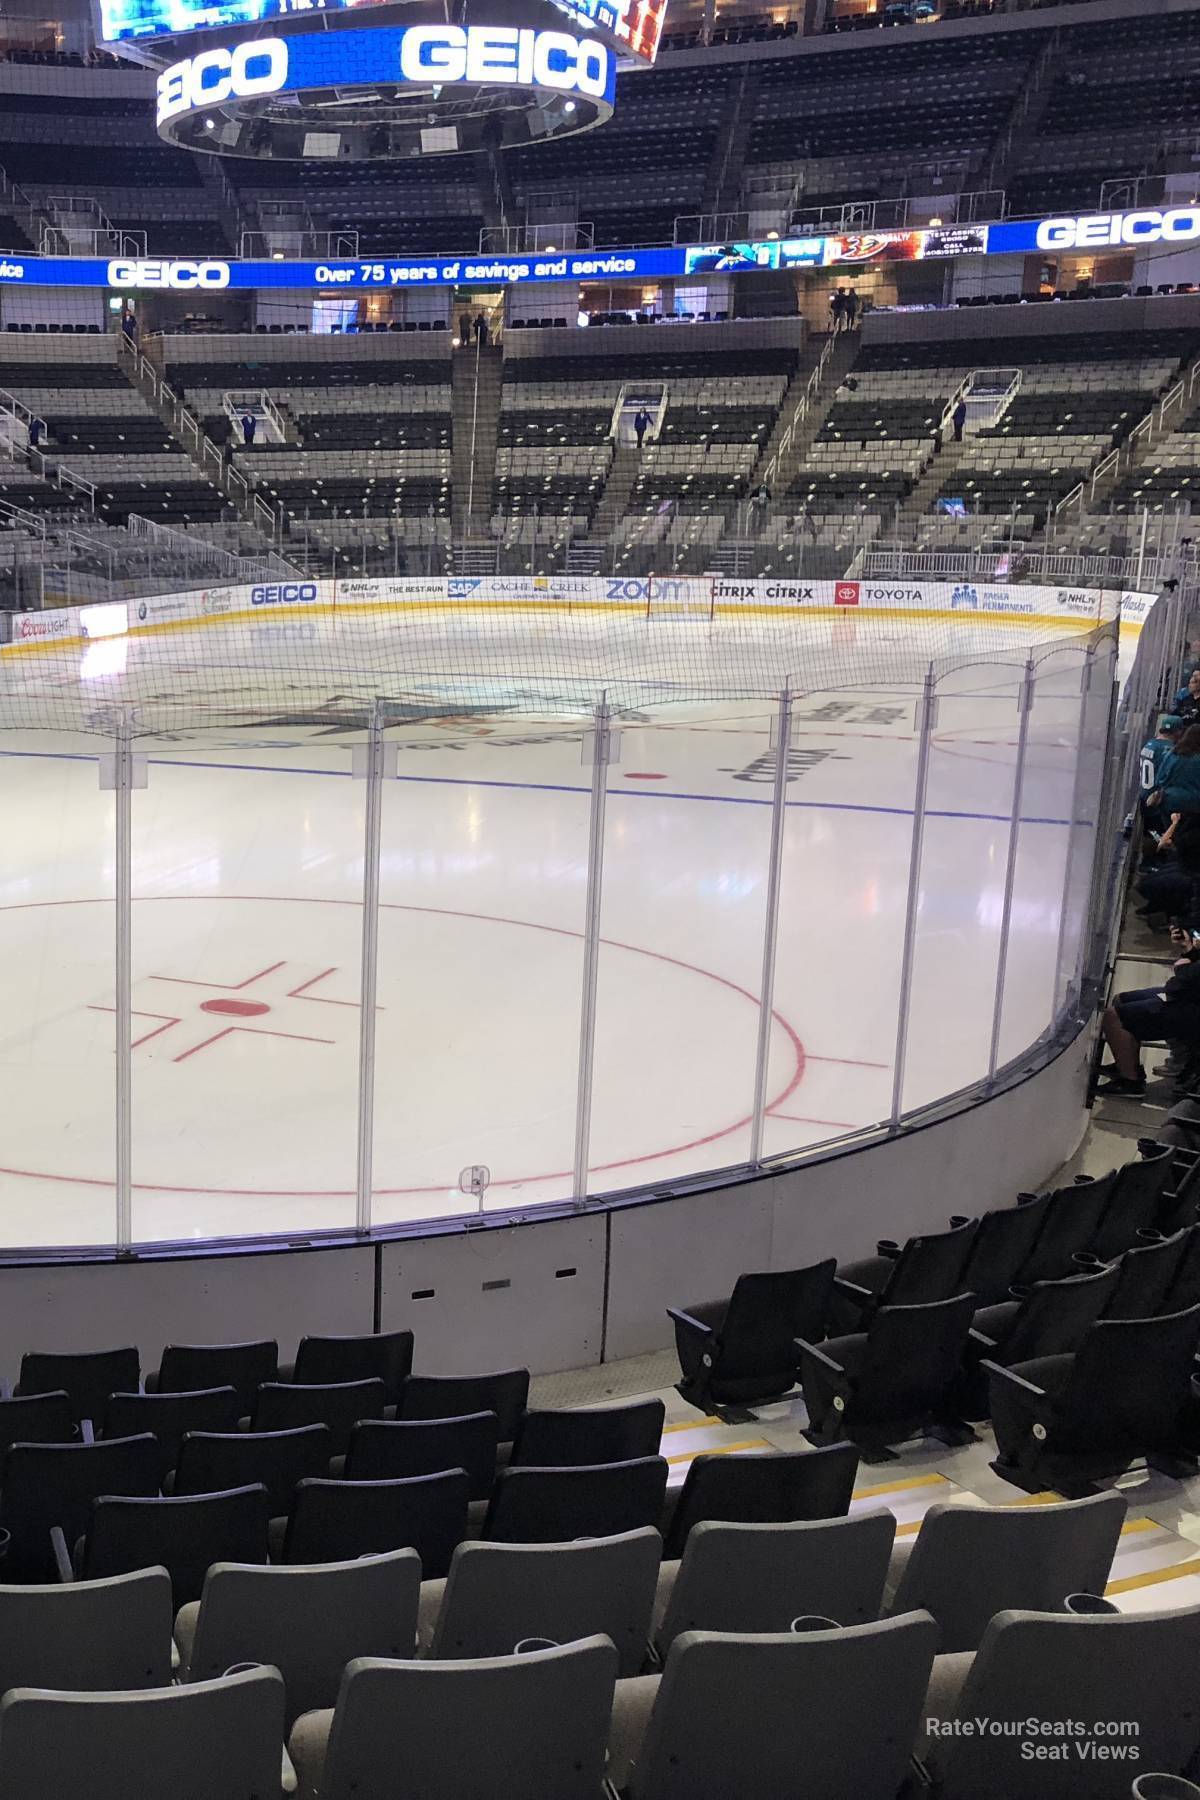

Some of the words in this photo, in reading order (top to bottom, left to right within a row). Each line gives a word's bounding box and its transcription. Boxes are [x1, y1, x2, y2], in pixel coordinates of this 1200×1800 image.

[400, 25, 607, 97] GEICO
[1036, 208, 1200, 249] GEICO
[107, 260, 230, 288] GEICO
[315, 266, 355, 283] Over
[361, 264, 385, 281] 75
[390, 264, 438, 287] years
[442, 262, 460, 279] of
[465, 260, 530, 282] savings
[534, 258, 566, 276] and
[572, 256, 636, 274] service
[251, 584, 316, 605] GEICO
[405, 585, 424, 593] BEST
[448, 583, 474, 594] SAP
[550, 583, 590, 592] CREEK
[606, 579, 690, 600] zoom
[865, 588, 923, 600] TOYOTA
[21, 618, 48, 638] Coors
[48, 618, 70, 634] LIGHT
